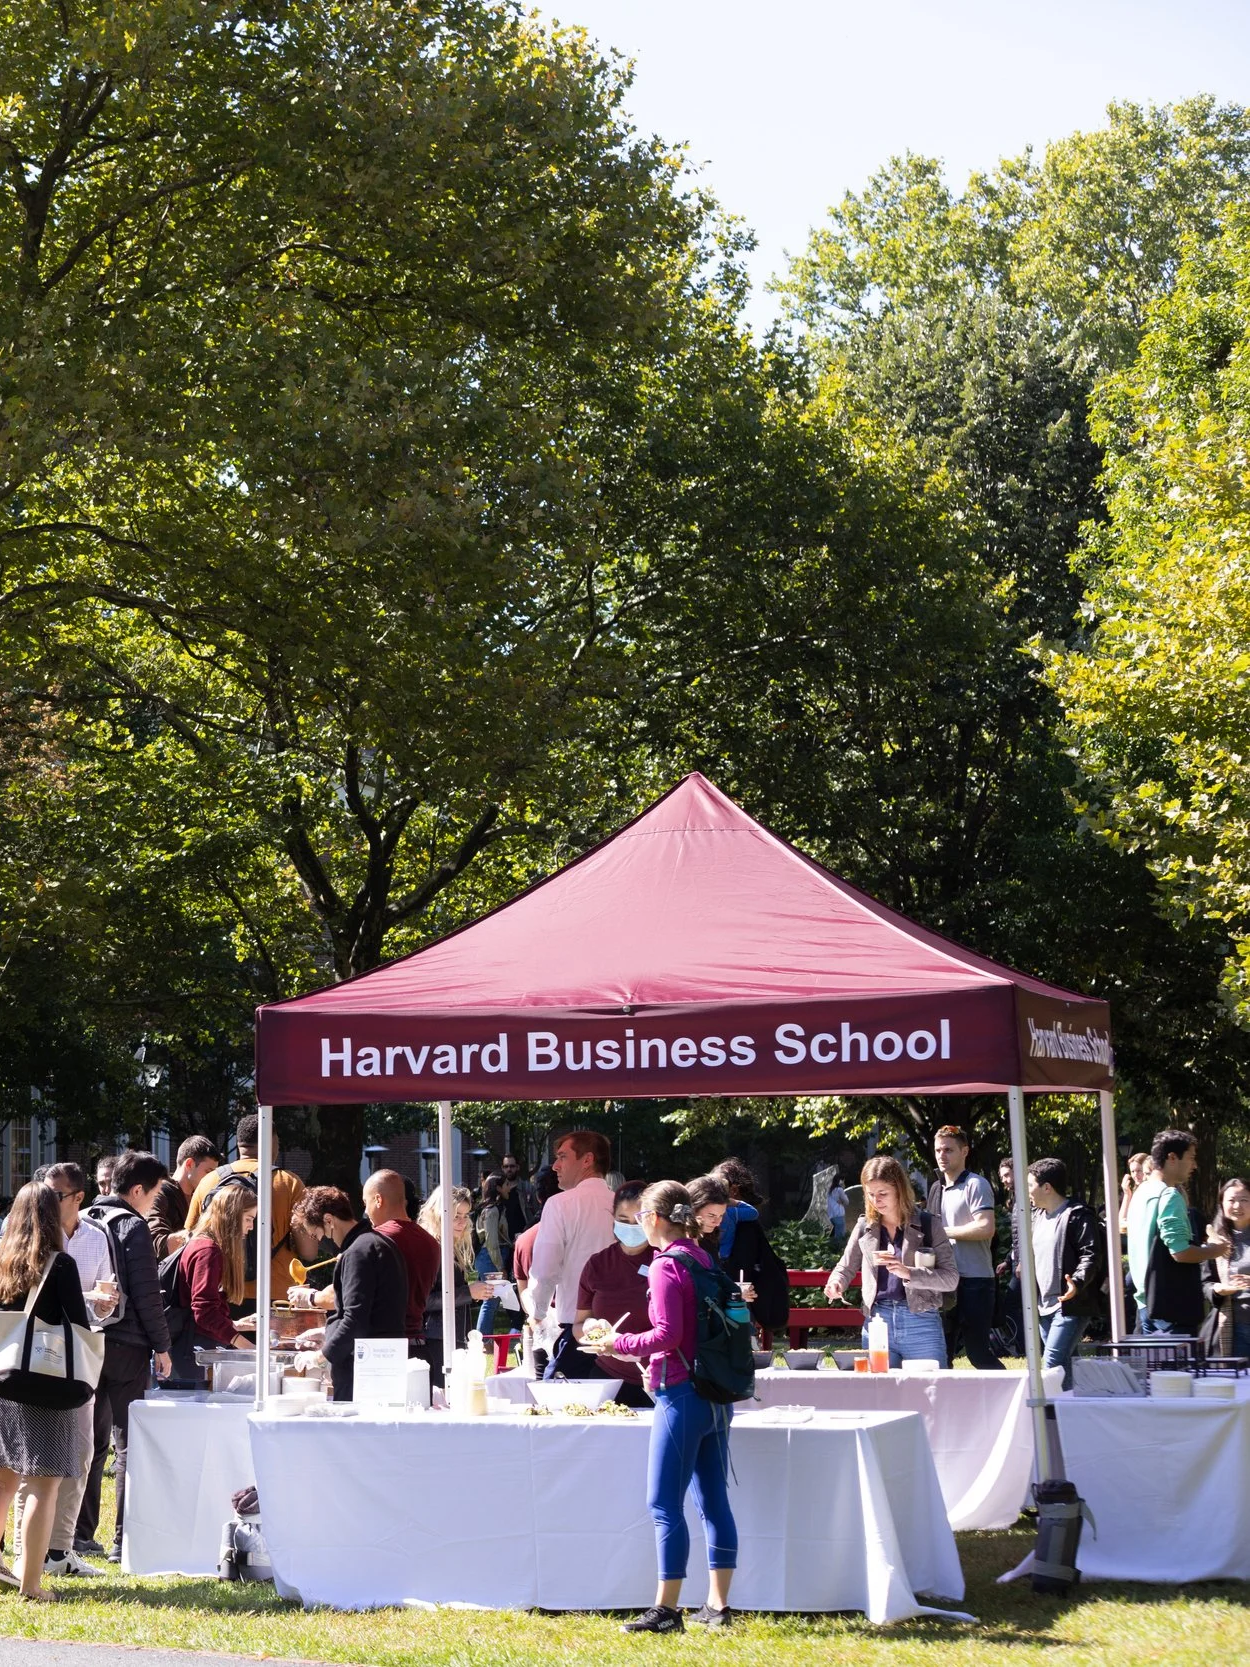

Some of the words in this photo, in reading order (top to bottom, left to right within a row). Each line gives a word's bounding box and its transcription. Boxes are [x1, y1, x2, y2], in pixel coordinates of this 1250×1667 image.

[321, 1033, 509, 1077] Harvard
[527, 1029, 757, 1071] Business
[774, 1018, 951, 1065] School
[1028, 1017, 1062, 1058] Harvard
[1056, 1021, 1093, 1062] Business
